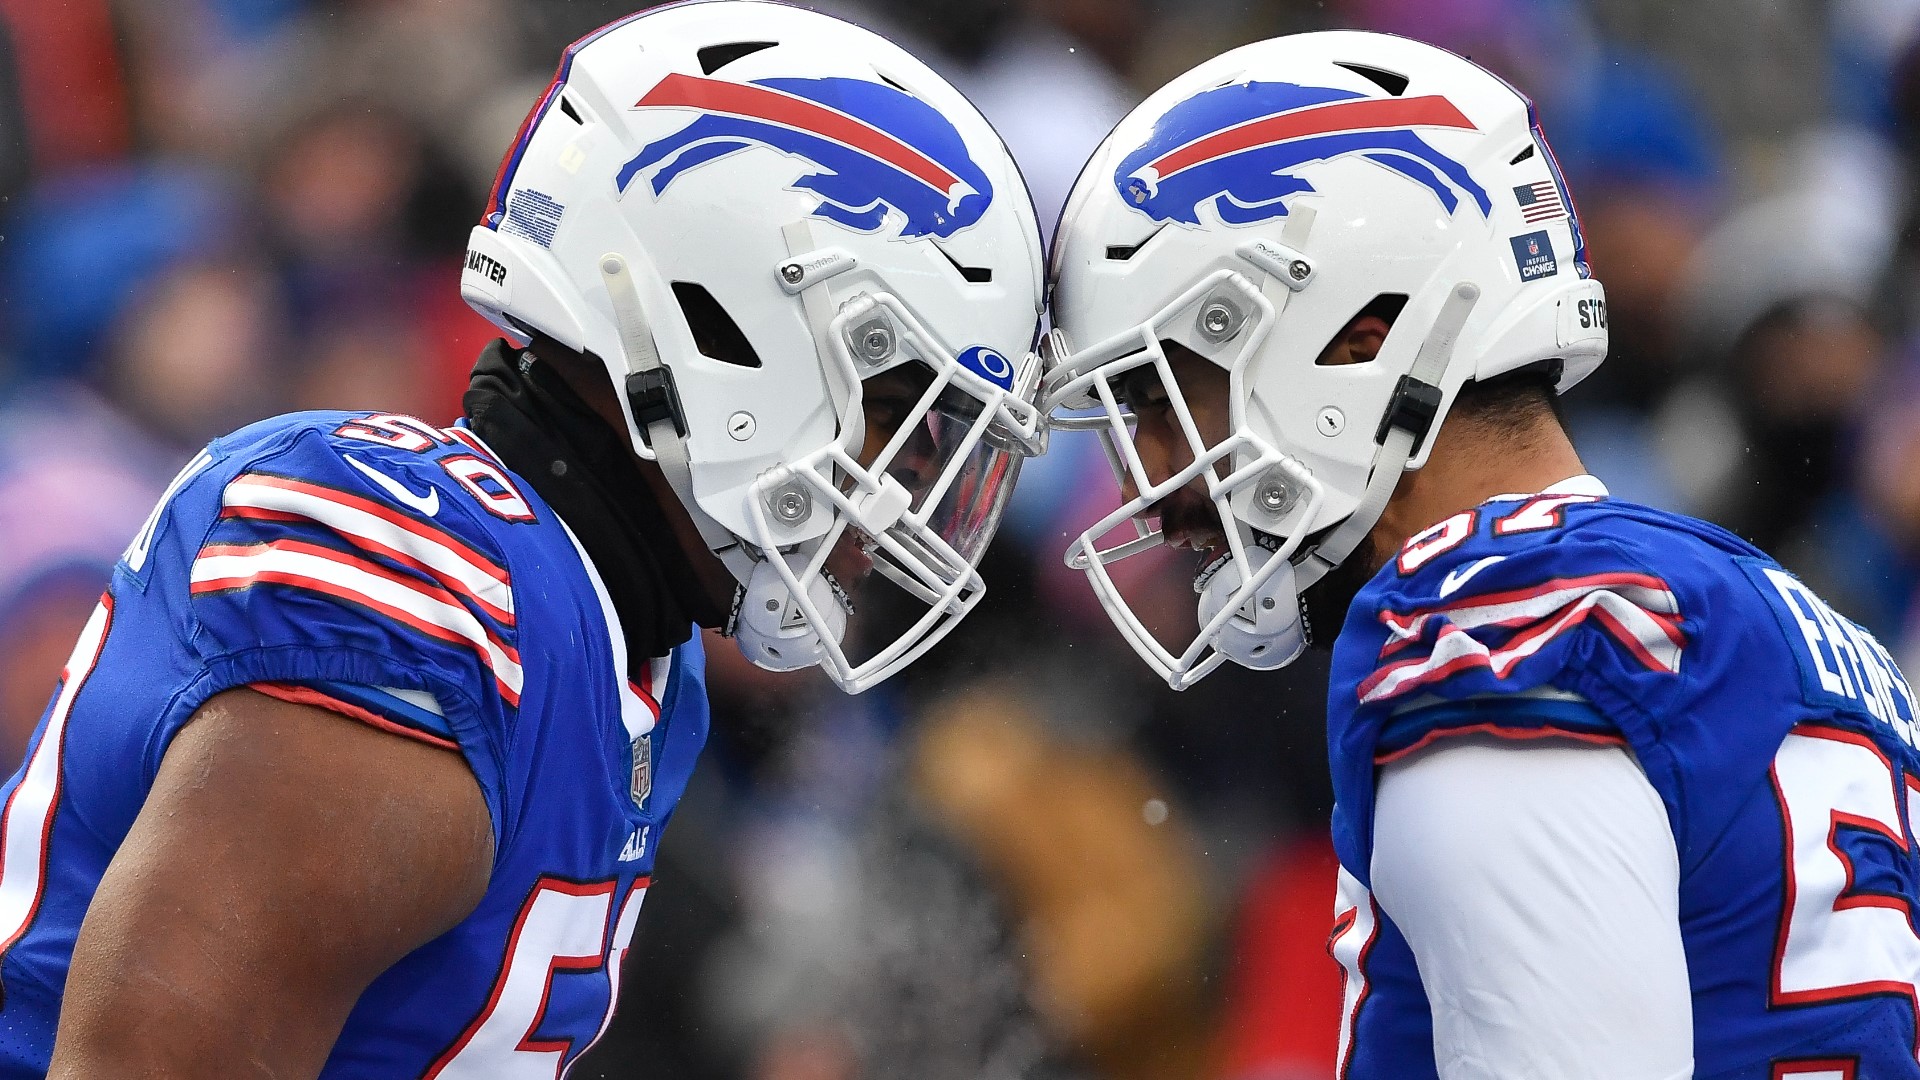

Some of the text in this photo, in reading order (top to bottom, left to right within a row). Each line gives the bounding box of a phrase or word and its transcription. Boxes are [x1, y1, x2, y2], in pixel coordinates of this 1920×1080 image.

[1525, 254, 1549, 266] INSPIRE
[468, 250, 507, 287] MATTER
[1522, 261, 1555, 277] CHANGE
